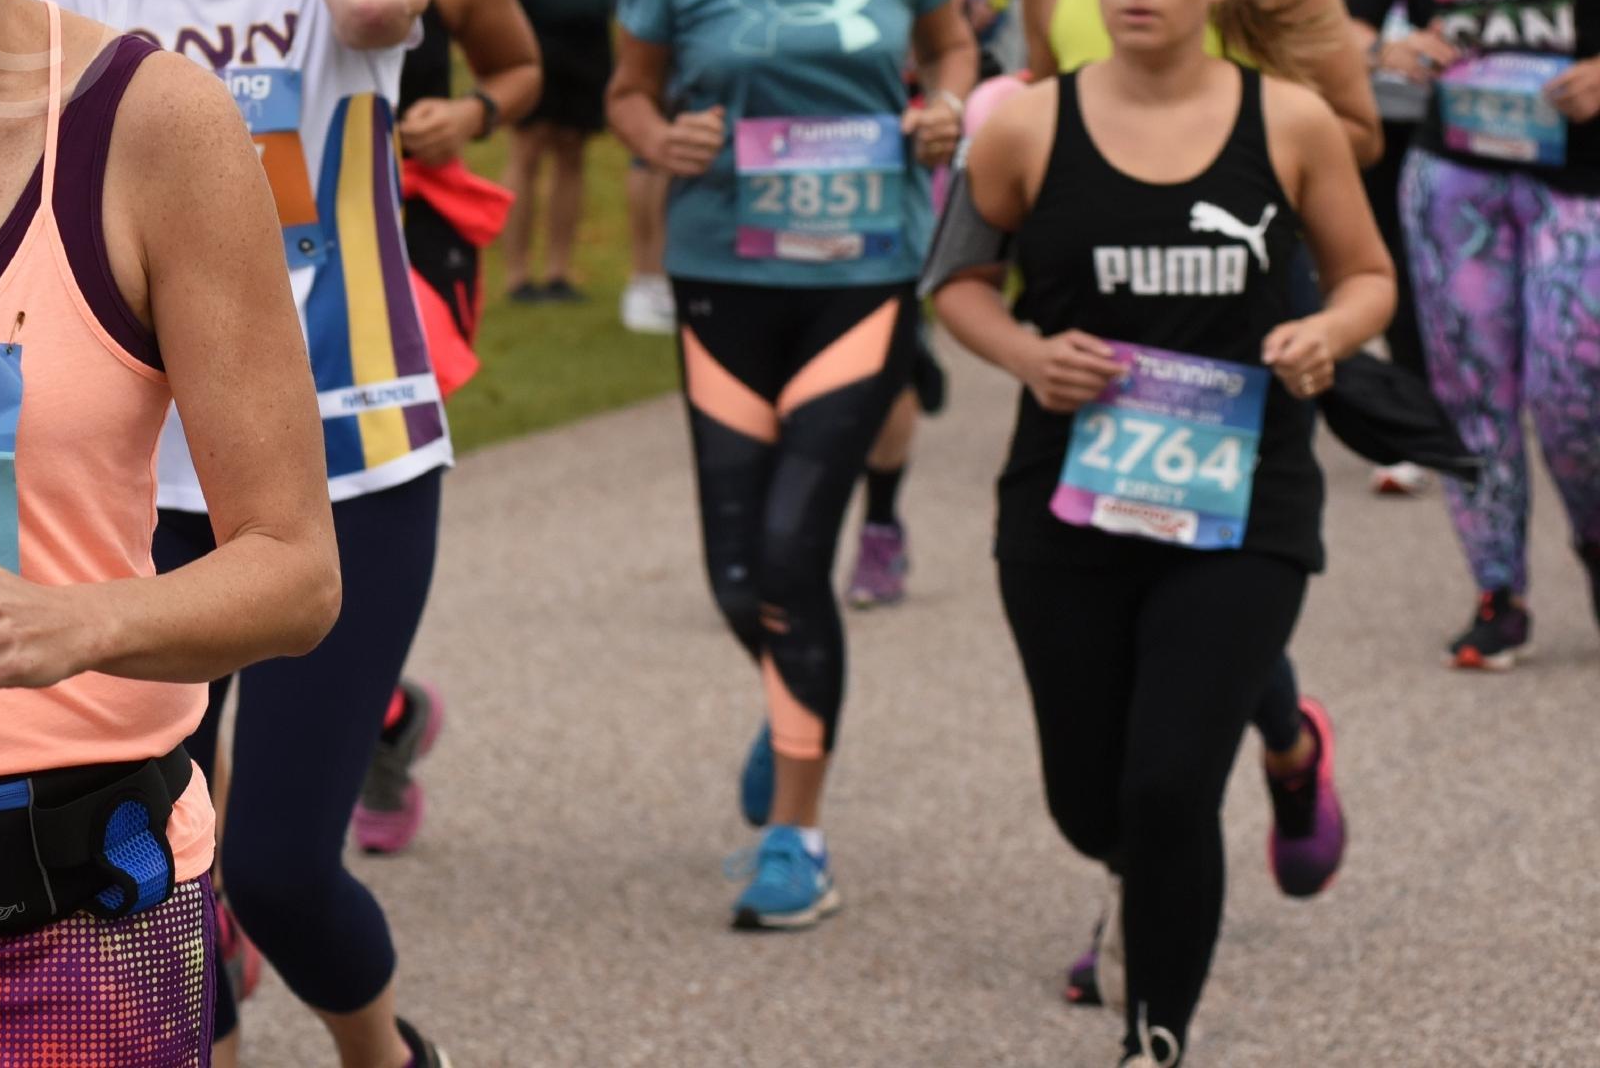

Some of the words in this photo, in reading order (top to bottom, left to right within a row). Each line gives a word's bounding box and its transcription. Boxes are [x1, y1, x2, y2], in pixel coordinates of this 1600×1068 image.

[125, 12, 298, 69] NN
[750, 172, 883, 216] 2851
[1092, 246, 1249, 295] PUMA
[1135, 353, 1245, 398] running
[1078, 414, 1243, 493] 2764
